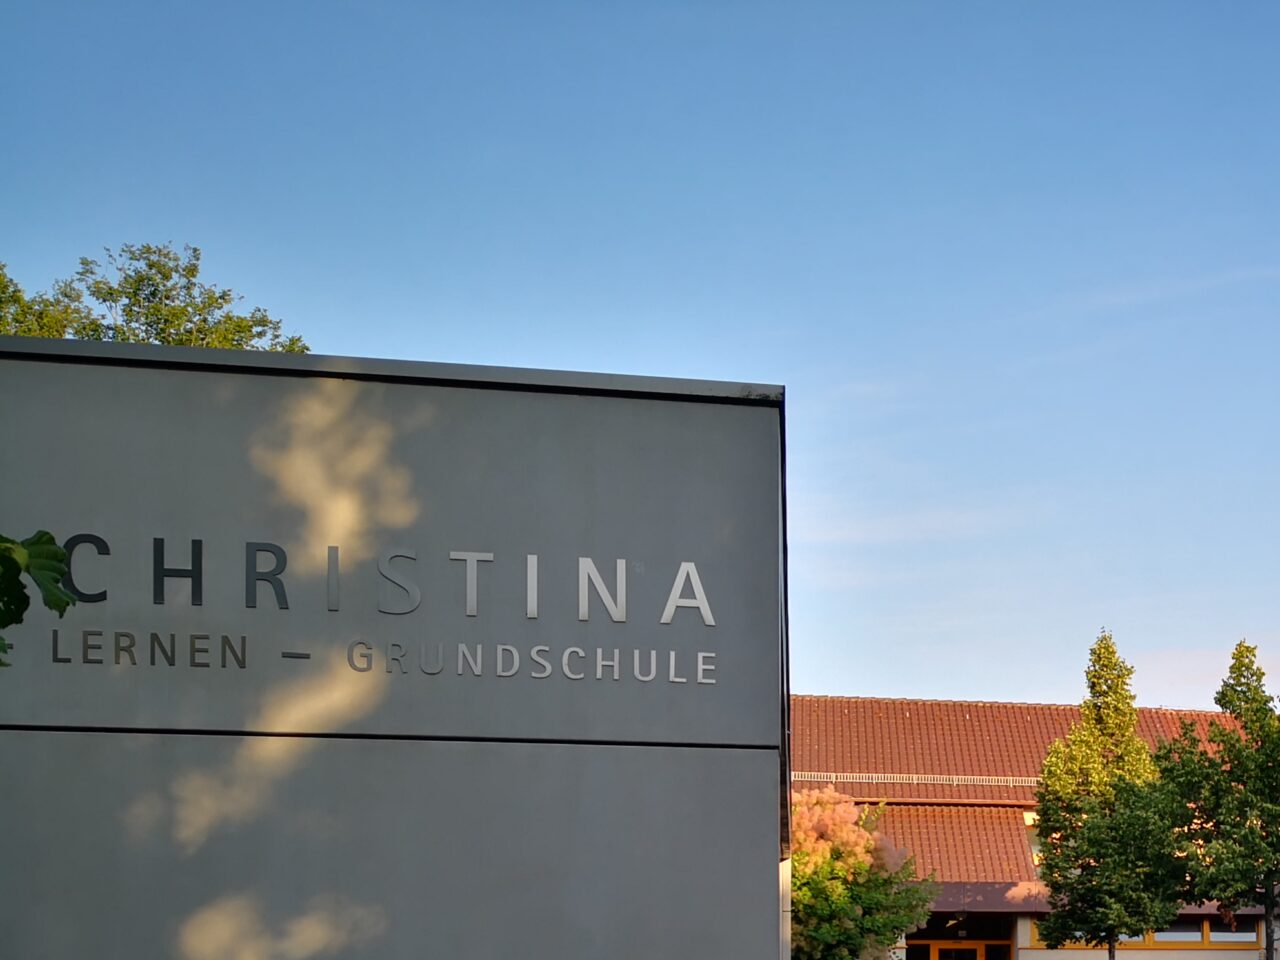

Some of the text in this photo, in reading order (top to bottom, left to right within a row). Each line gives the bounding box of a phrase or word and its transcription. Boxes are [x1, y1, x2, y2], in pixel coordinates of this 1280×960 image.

[62, 533, 716, 626] CHRISTINA
[52, 629, 247, 669] LERNEN
[347, 639, 716, 684] GRUNDSCHULE
